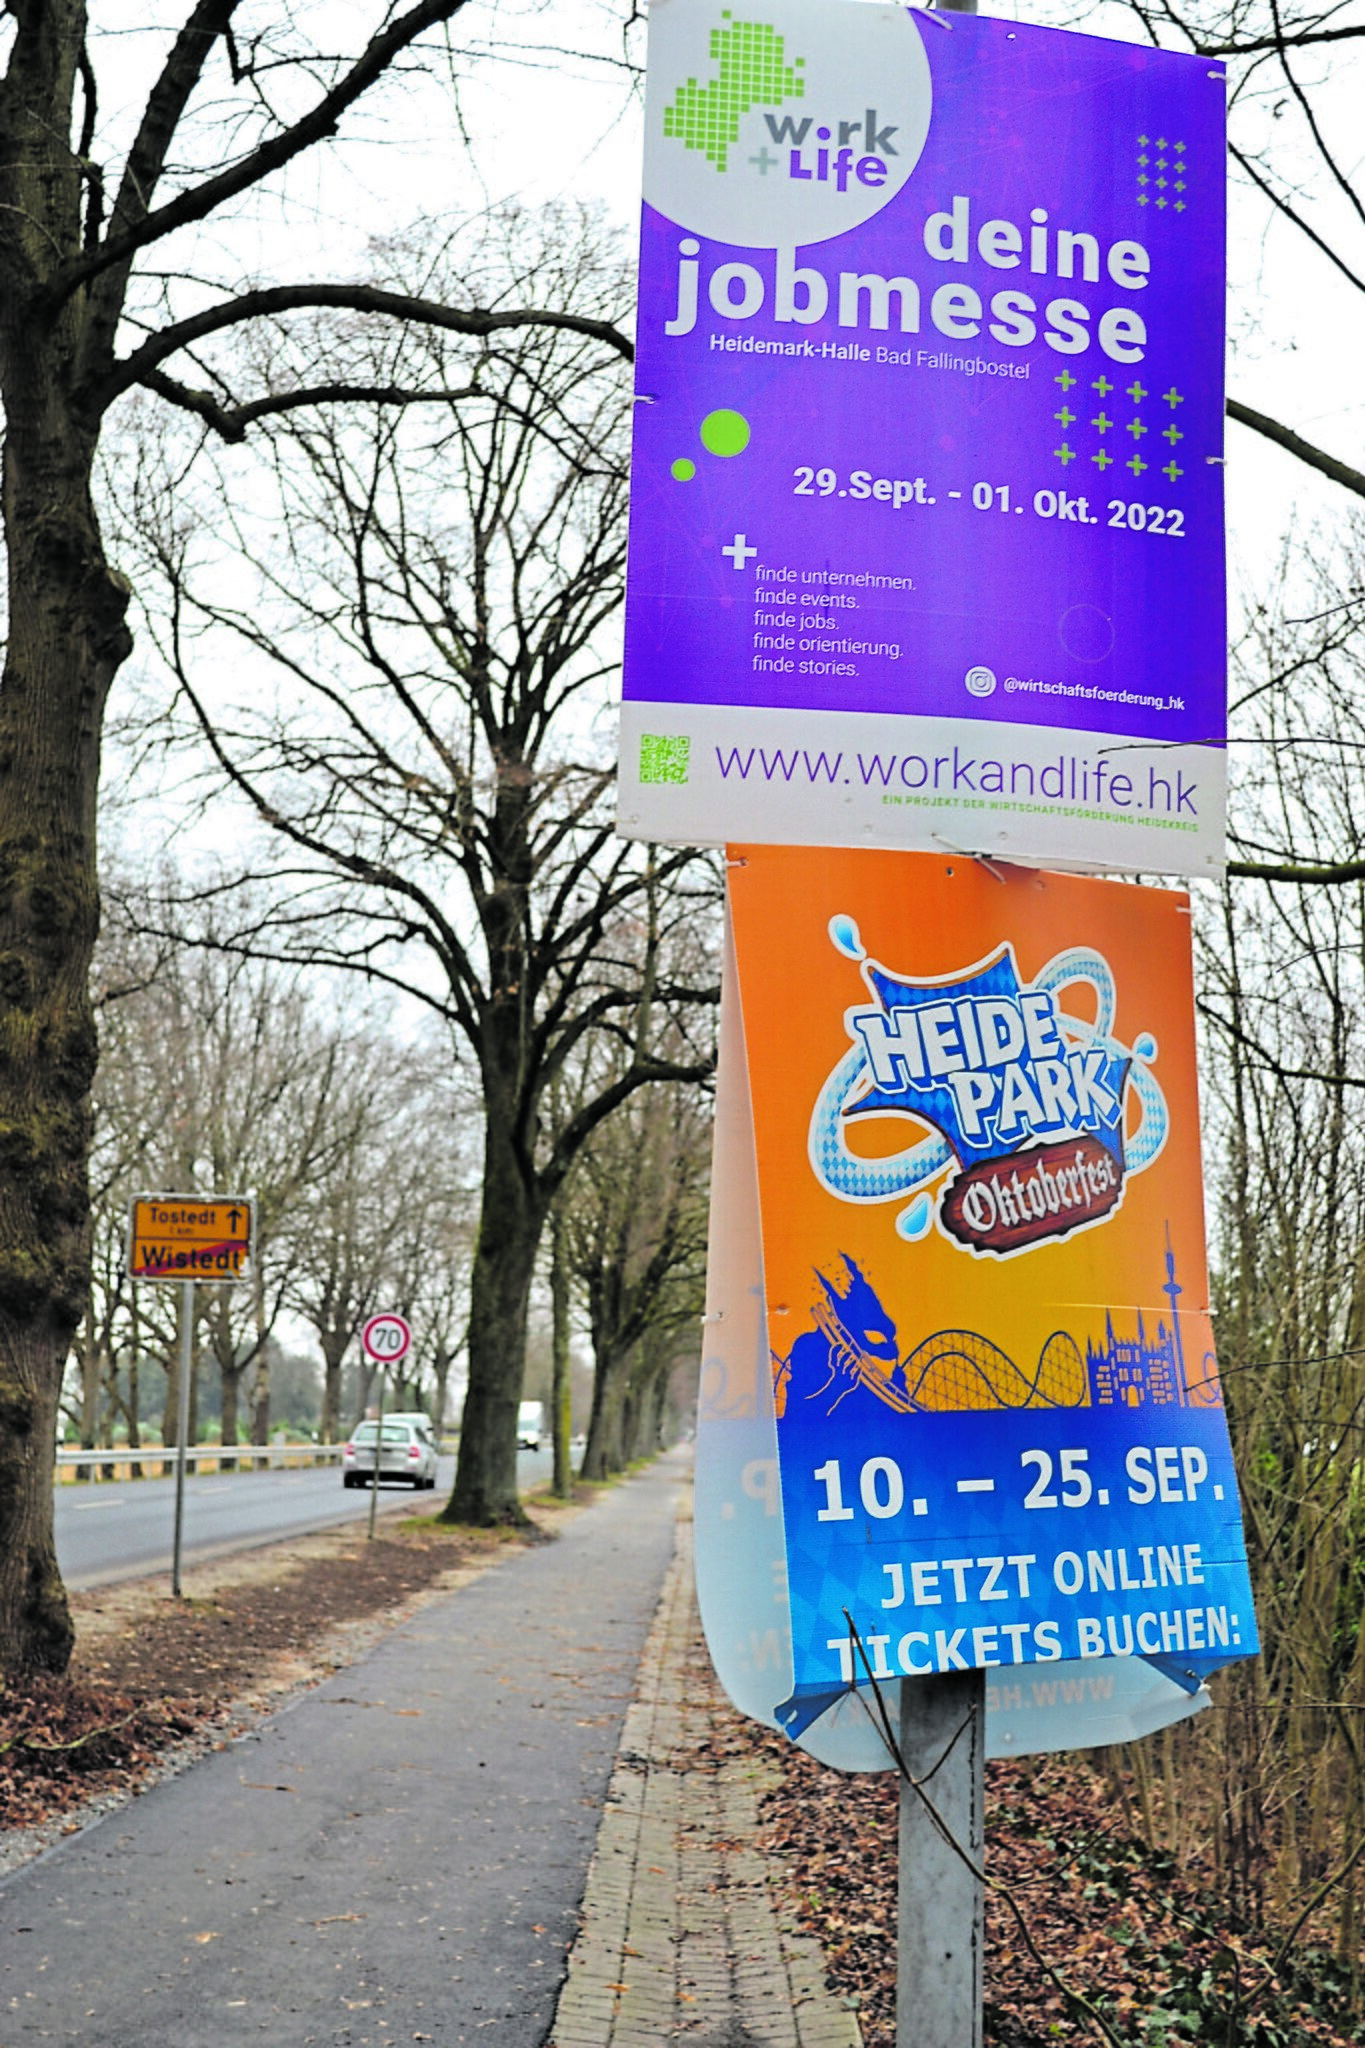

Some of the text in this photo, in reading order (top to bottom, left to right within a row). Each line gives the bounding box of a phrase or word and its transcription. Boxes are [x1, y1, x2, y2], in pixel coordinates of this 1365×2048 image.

[924, 196, 1151, 290] deine
[665, 238, 1147, 363] jobmesse
[710, 334, 1030, 379] Heidemark-Halle Bad Fallingbostel
[793, 466, 936, 509] 29.Sept.
[972, 482, 1024, 515] 01.
[1034, 490, 1098, 524] Okt.
[1107, 500, 1186, 538] 2022
[754, 587, 860, 609] finde events.
[755, 565, 916, 590] finde unternehmen.
[753, 610, 839, 632] finde jobs.
[752, 655, 860, 677] finde stories.
[753, 632, 904, 660] finde orientierung.
[1004, 677, 1185, 711] @wirtschaftsfoerderung_hk
[715, 745, 1198, 816] www.workandlife.hk
[882, 794, 902, 805] EIN
[906, 795, 959, 808] PROJEKT
[963, 797, 985, 809] DER
[1137, 817, 1199, 833] HEIDEKREIS
[856, 992, 1063, 1084] HEIDE
[953, 1050, 1119, 1135] PARK
[962, 1153, 1118, 1233] Oktoberfest
[150, 1207, 216, 1225] Tostedt
[142, 1245, 240, 1270] Wistedt
[375, 1328, 401, 1350] 70
[813, 1458, 929, 1522] 10.
[1021, 1448, 1110, 1509] 25.
[1126, 1446, 1225, 1502] SEP.
[881, 1543, 1205, 1609] JETZT ONLINE
[827, 1621, 1062, 1683] TICKETS
[1078, 1606, 1241, 1657] BUCHEN:
